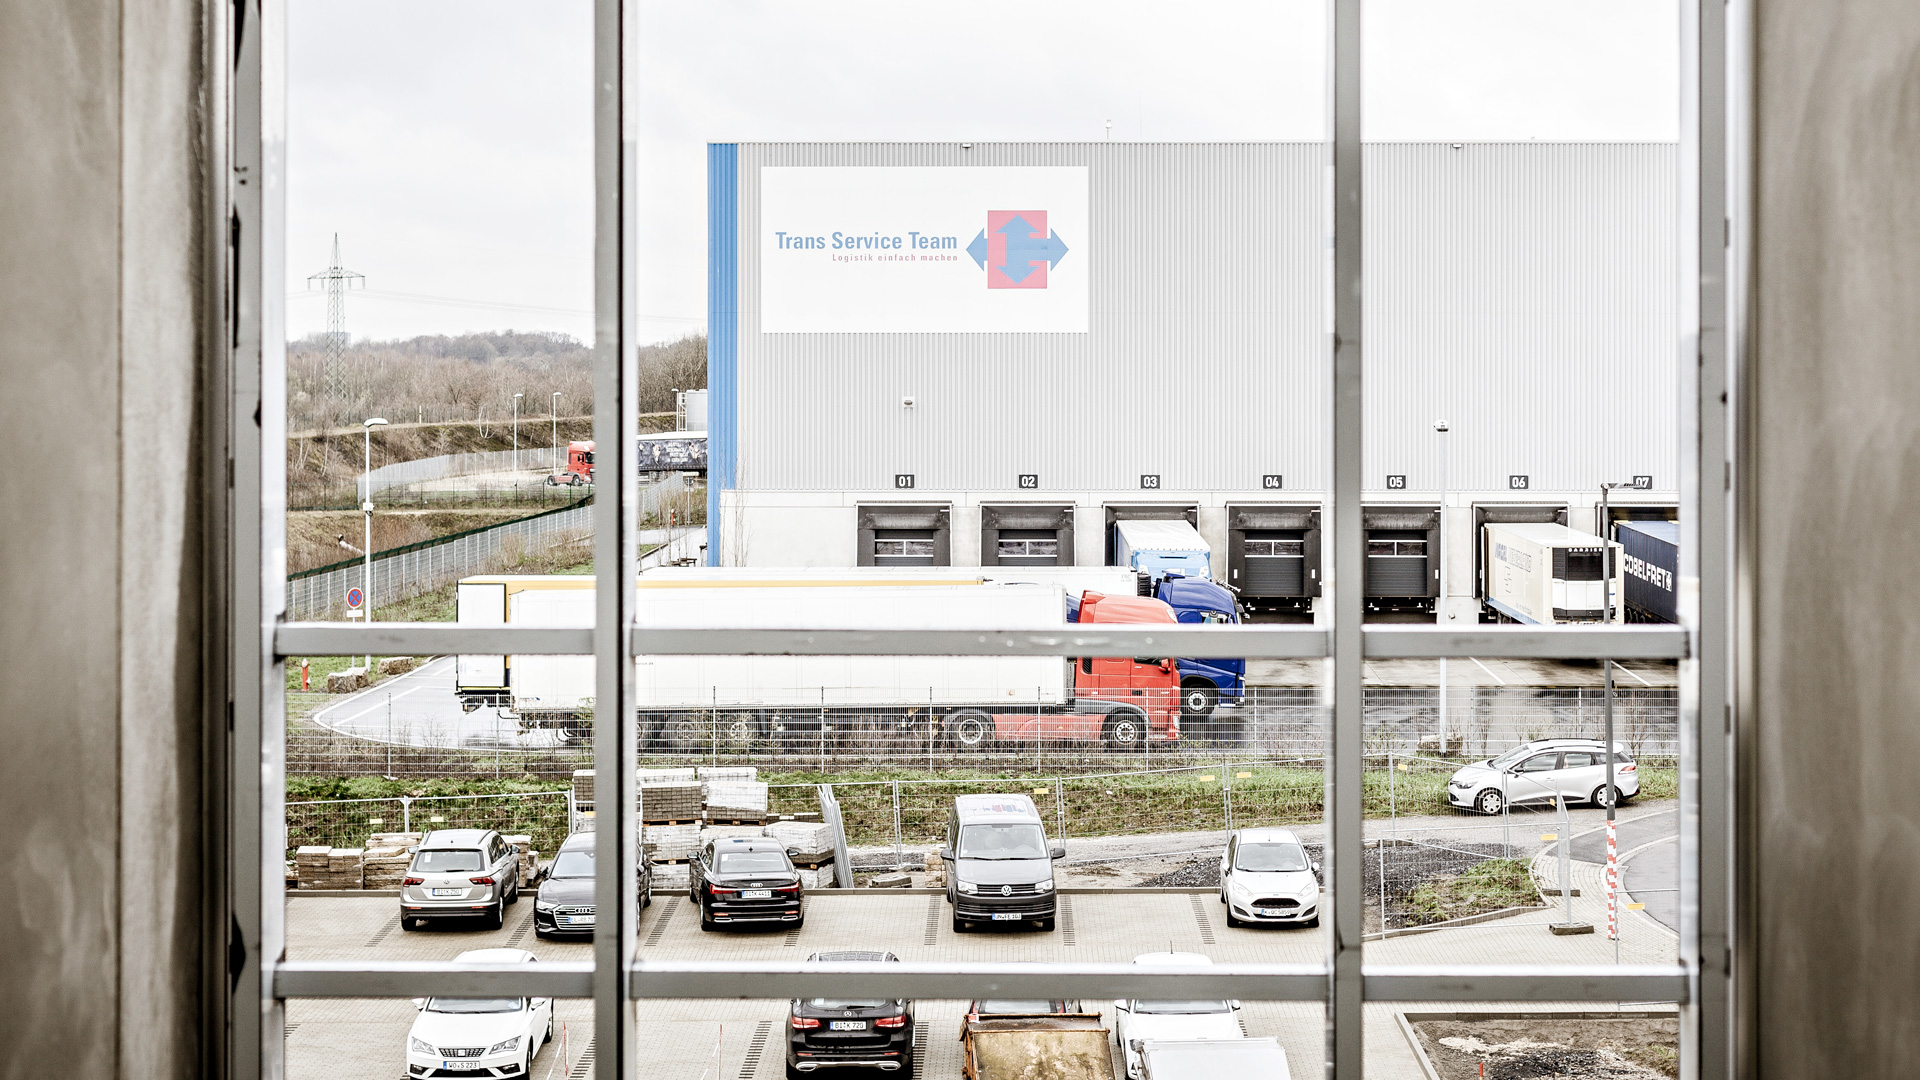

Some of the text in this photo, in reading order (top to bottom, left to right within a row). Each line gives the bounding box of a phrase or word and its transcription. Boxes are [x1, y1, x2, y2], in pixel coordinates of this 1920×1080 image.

[775, 231, 957, 250] Trans Service Team
[832, 253, 958, 263] Logistik einfach machen
[898, 475, 911, 487] 01
[1021, 475, 1036, 487] 02
[1143, 476, 1158, 488] 03
[1265, 476, 1280, 488] 04
[1389, 476, 1403, 488] 05
[1511, 476, 1526, 488] 06
[1635, 476, 1650, 488] 07
[1624, 553, 1666, 589] COBELFRET
